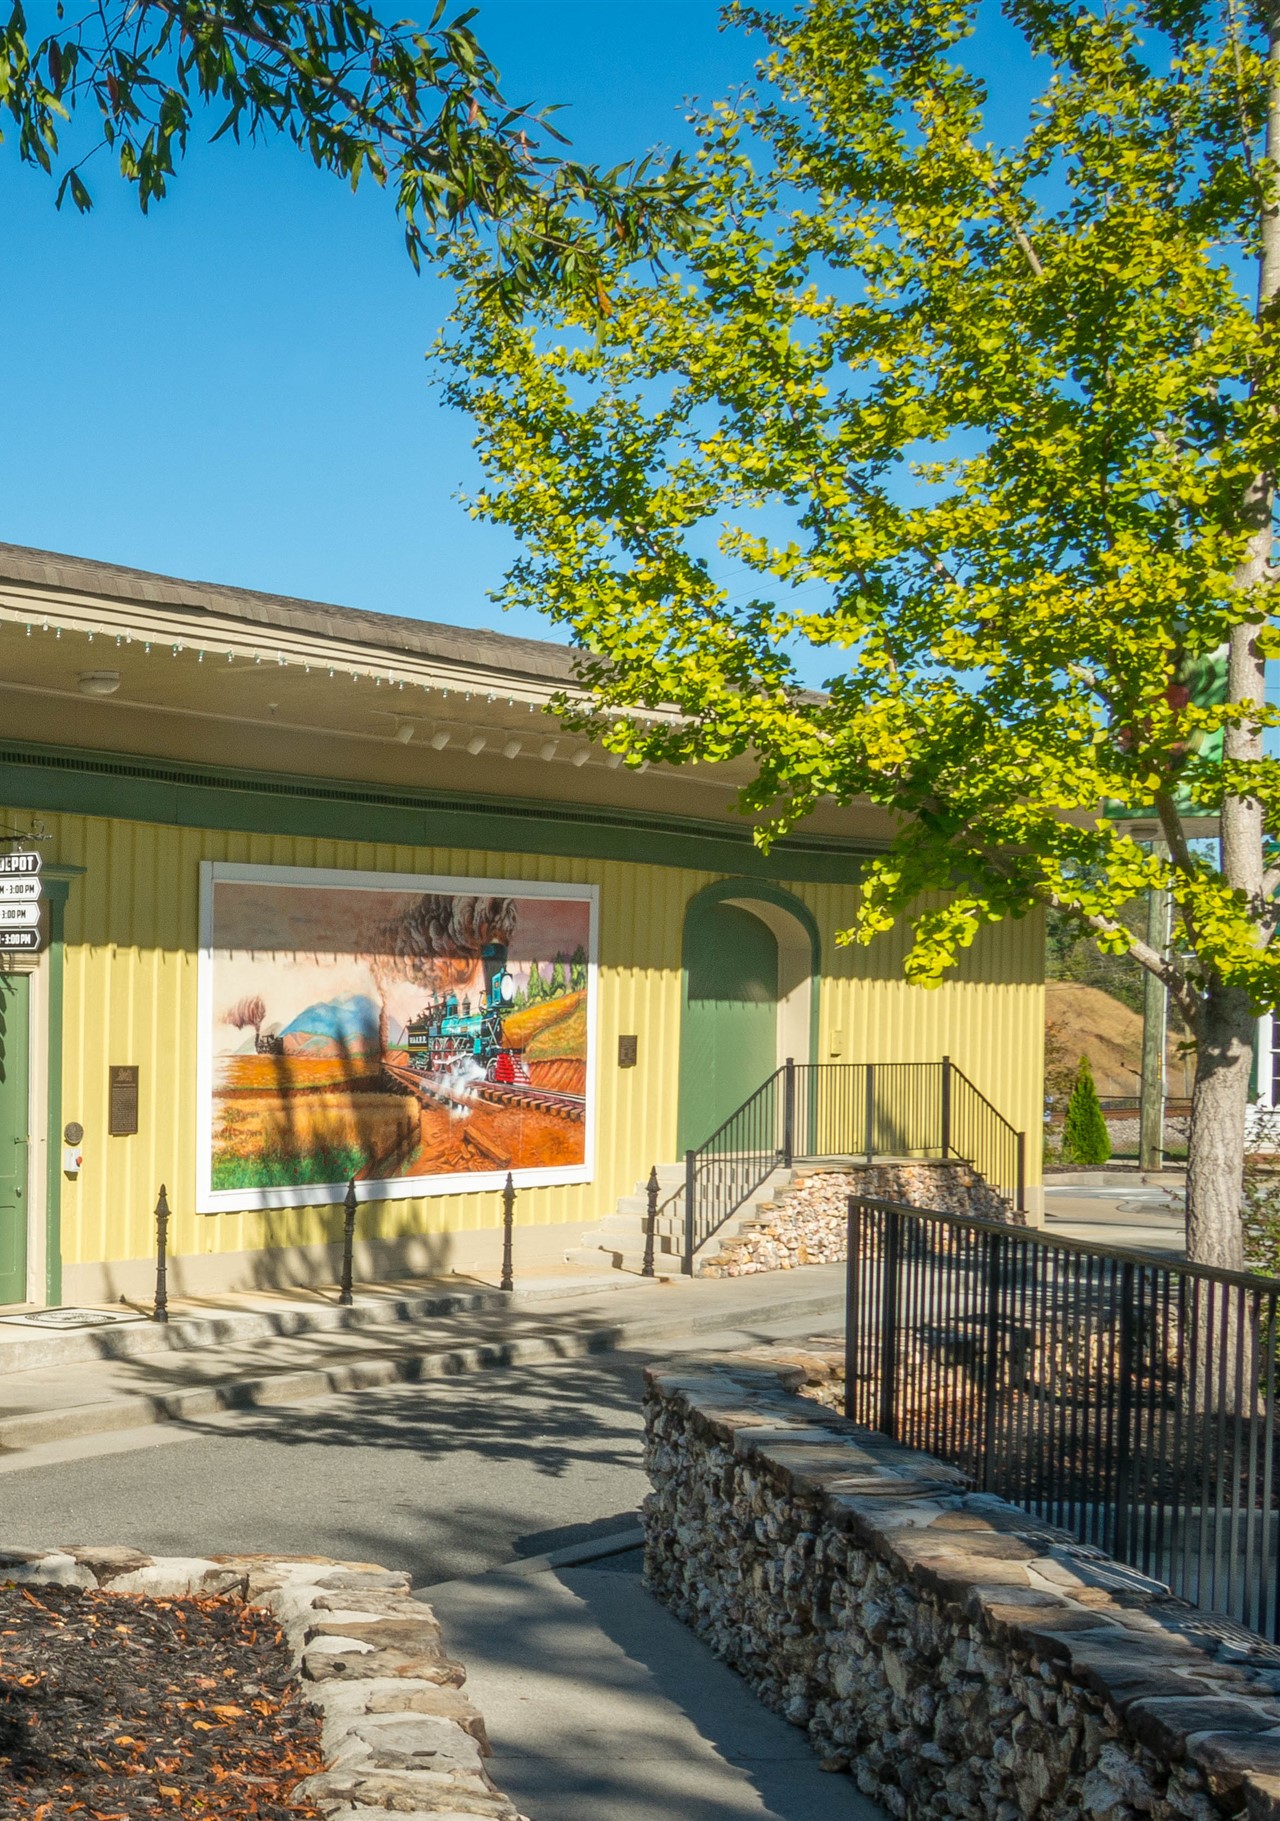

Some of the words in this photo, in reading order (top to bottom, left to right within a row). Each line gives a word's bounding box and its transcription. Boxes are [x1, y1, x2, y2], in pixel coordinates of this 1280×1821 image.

[9, 885, 24, 894] 3:00
[25, 884, 35, 894] PM
[2, 910, 16, 919] 3:00
[17, 909, 26, 919] PM
[4, 933, 20, 944] 3:00
[20, 933, 31, 944] PM
